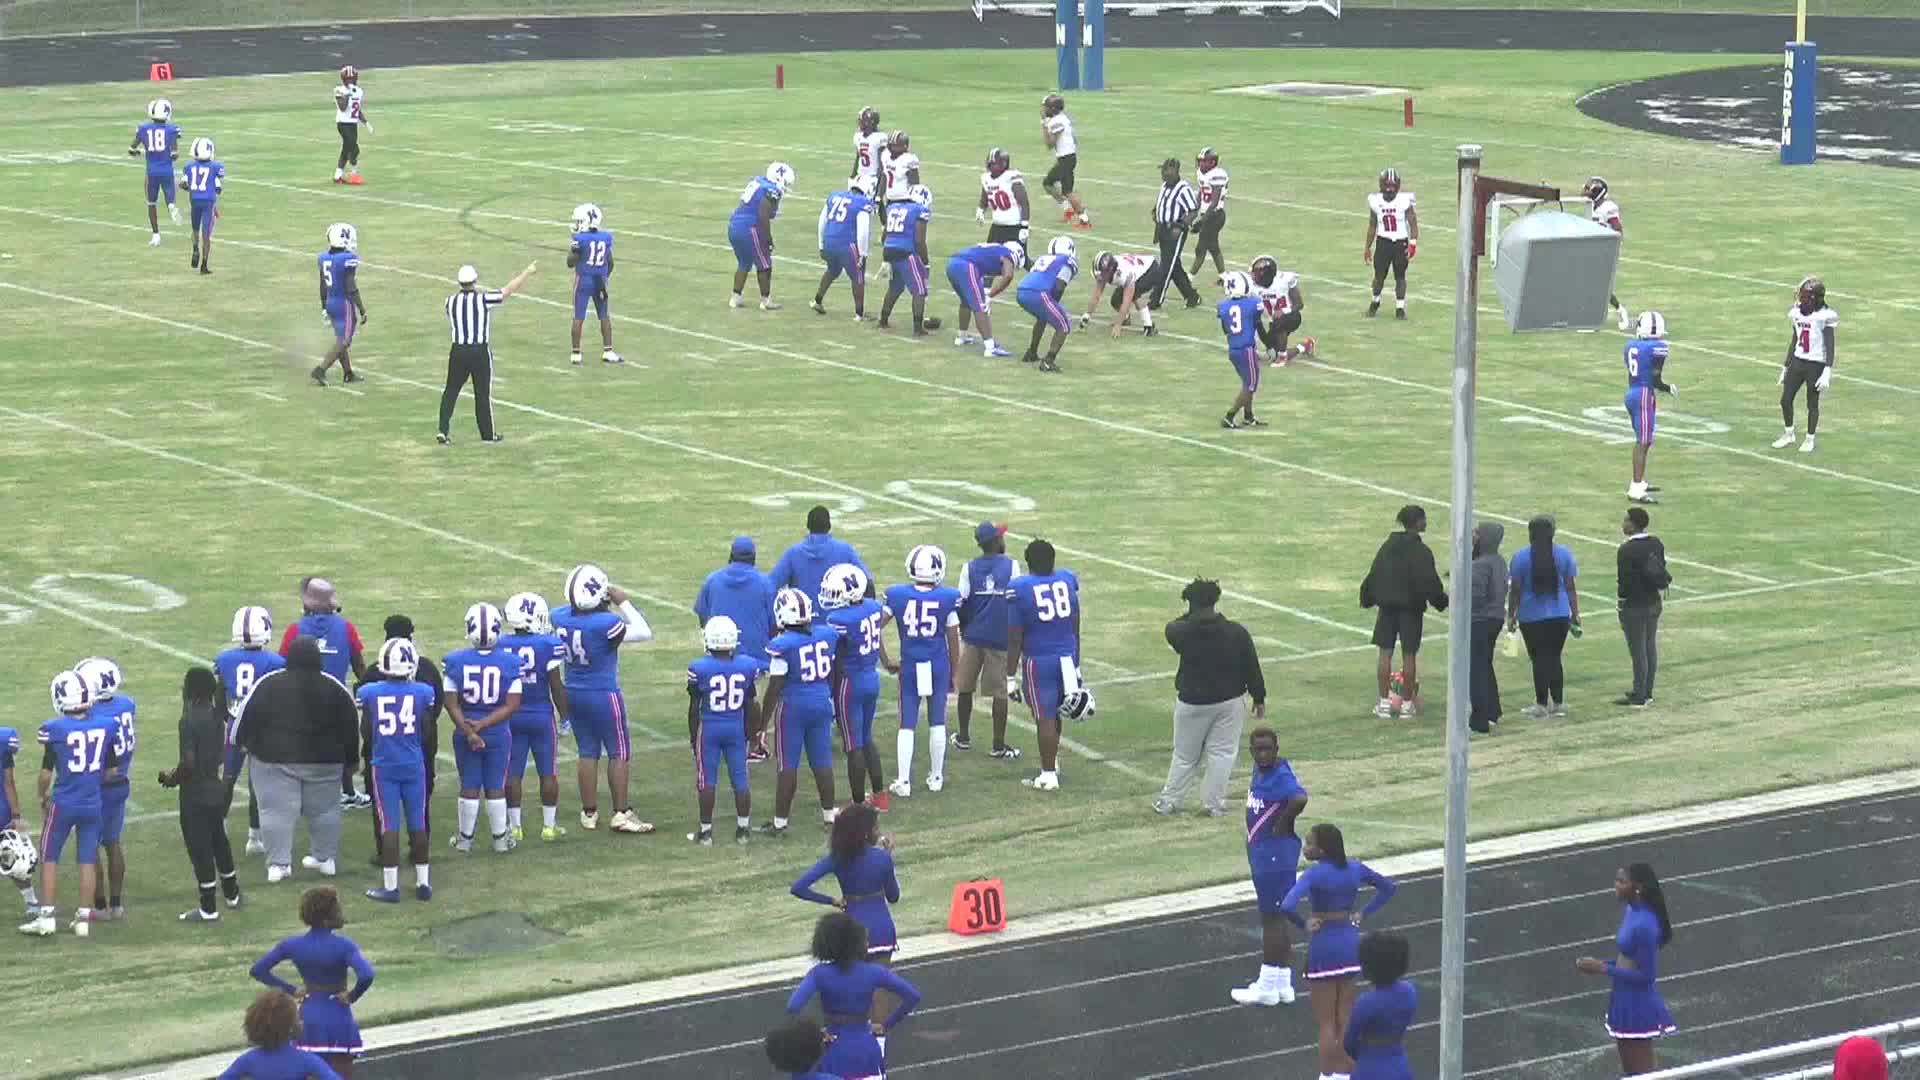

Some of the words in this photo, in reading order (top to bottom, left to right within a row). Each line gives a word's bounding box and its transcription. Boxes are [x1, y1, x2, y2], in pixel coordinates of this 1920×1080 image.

[157, 65, 169, 80] G
[1781, 50, 1793, 145] NORTH
[146, 128, 166, 152] 18
[860, 148, 870, 167] 5
[190, 167, 210, 191] 17
[827, 198, 851, 222] 75
[586, 240, 606, 266] 12
[323, 260, 333, 287] 5
[1229, 304, 1243, 334] 3
[1628, 347, 1639, 377] 6
[930, 553, 943, 570] N
[584, 577, 602, 597] N
[842, 573, 860, 592] N
[519, 598, 536, 616] N
[1034, 581, 1072, 623] 58
[902, 599, 940, 638] 45
[860, 612, 881, 656] 35
[399, 646, 416, 664] N
[798, 640, 832, 682] 56
[54, 680, 69, 699] N
[99, 670, 116, 689] N
[236, 662, 255, 698] 8
[463, 664, 501, 705] 50
[709, 673, 746, 712] 26
[377, 695, 416, 736] 54
[66, 728, 107, 773] 37
[963, 887, 1002, 929] 30
